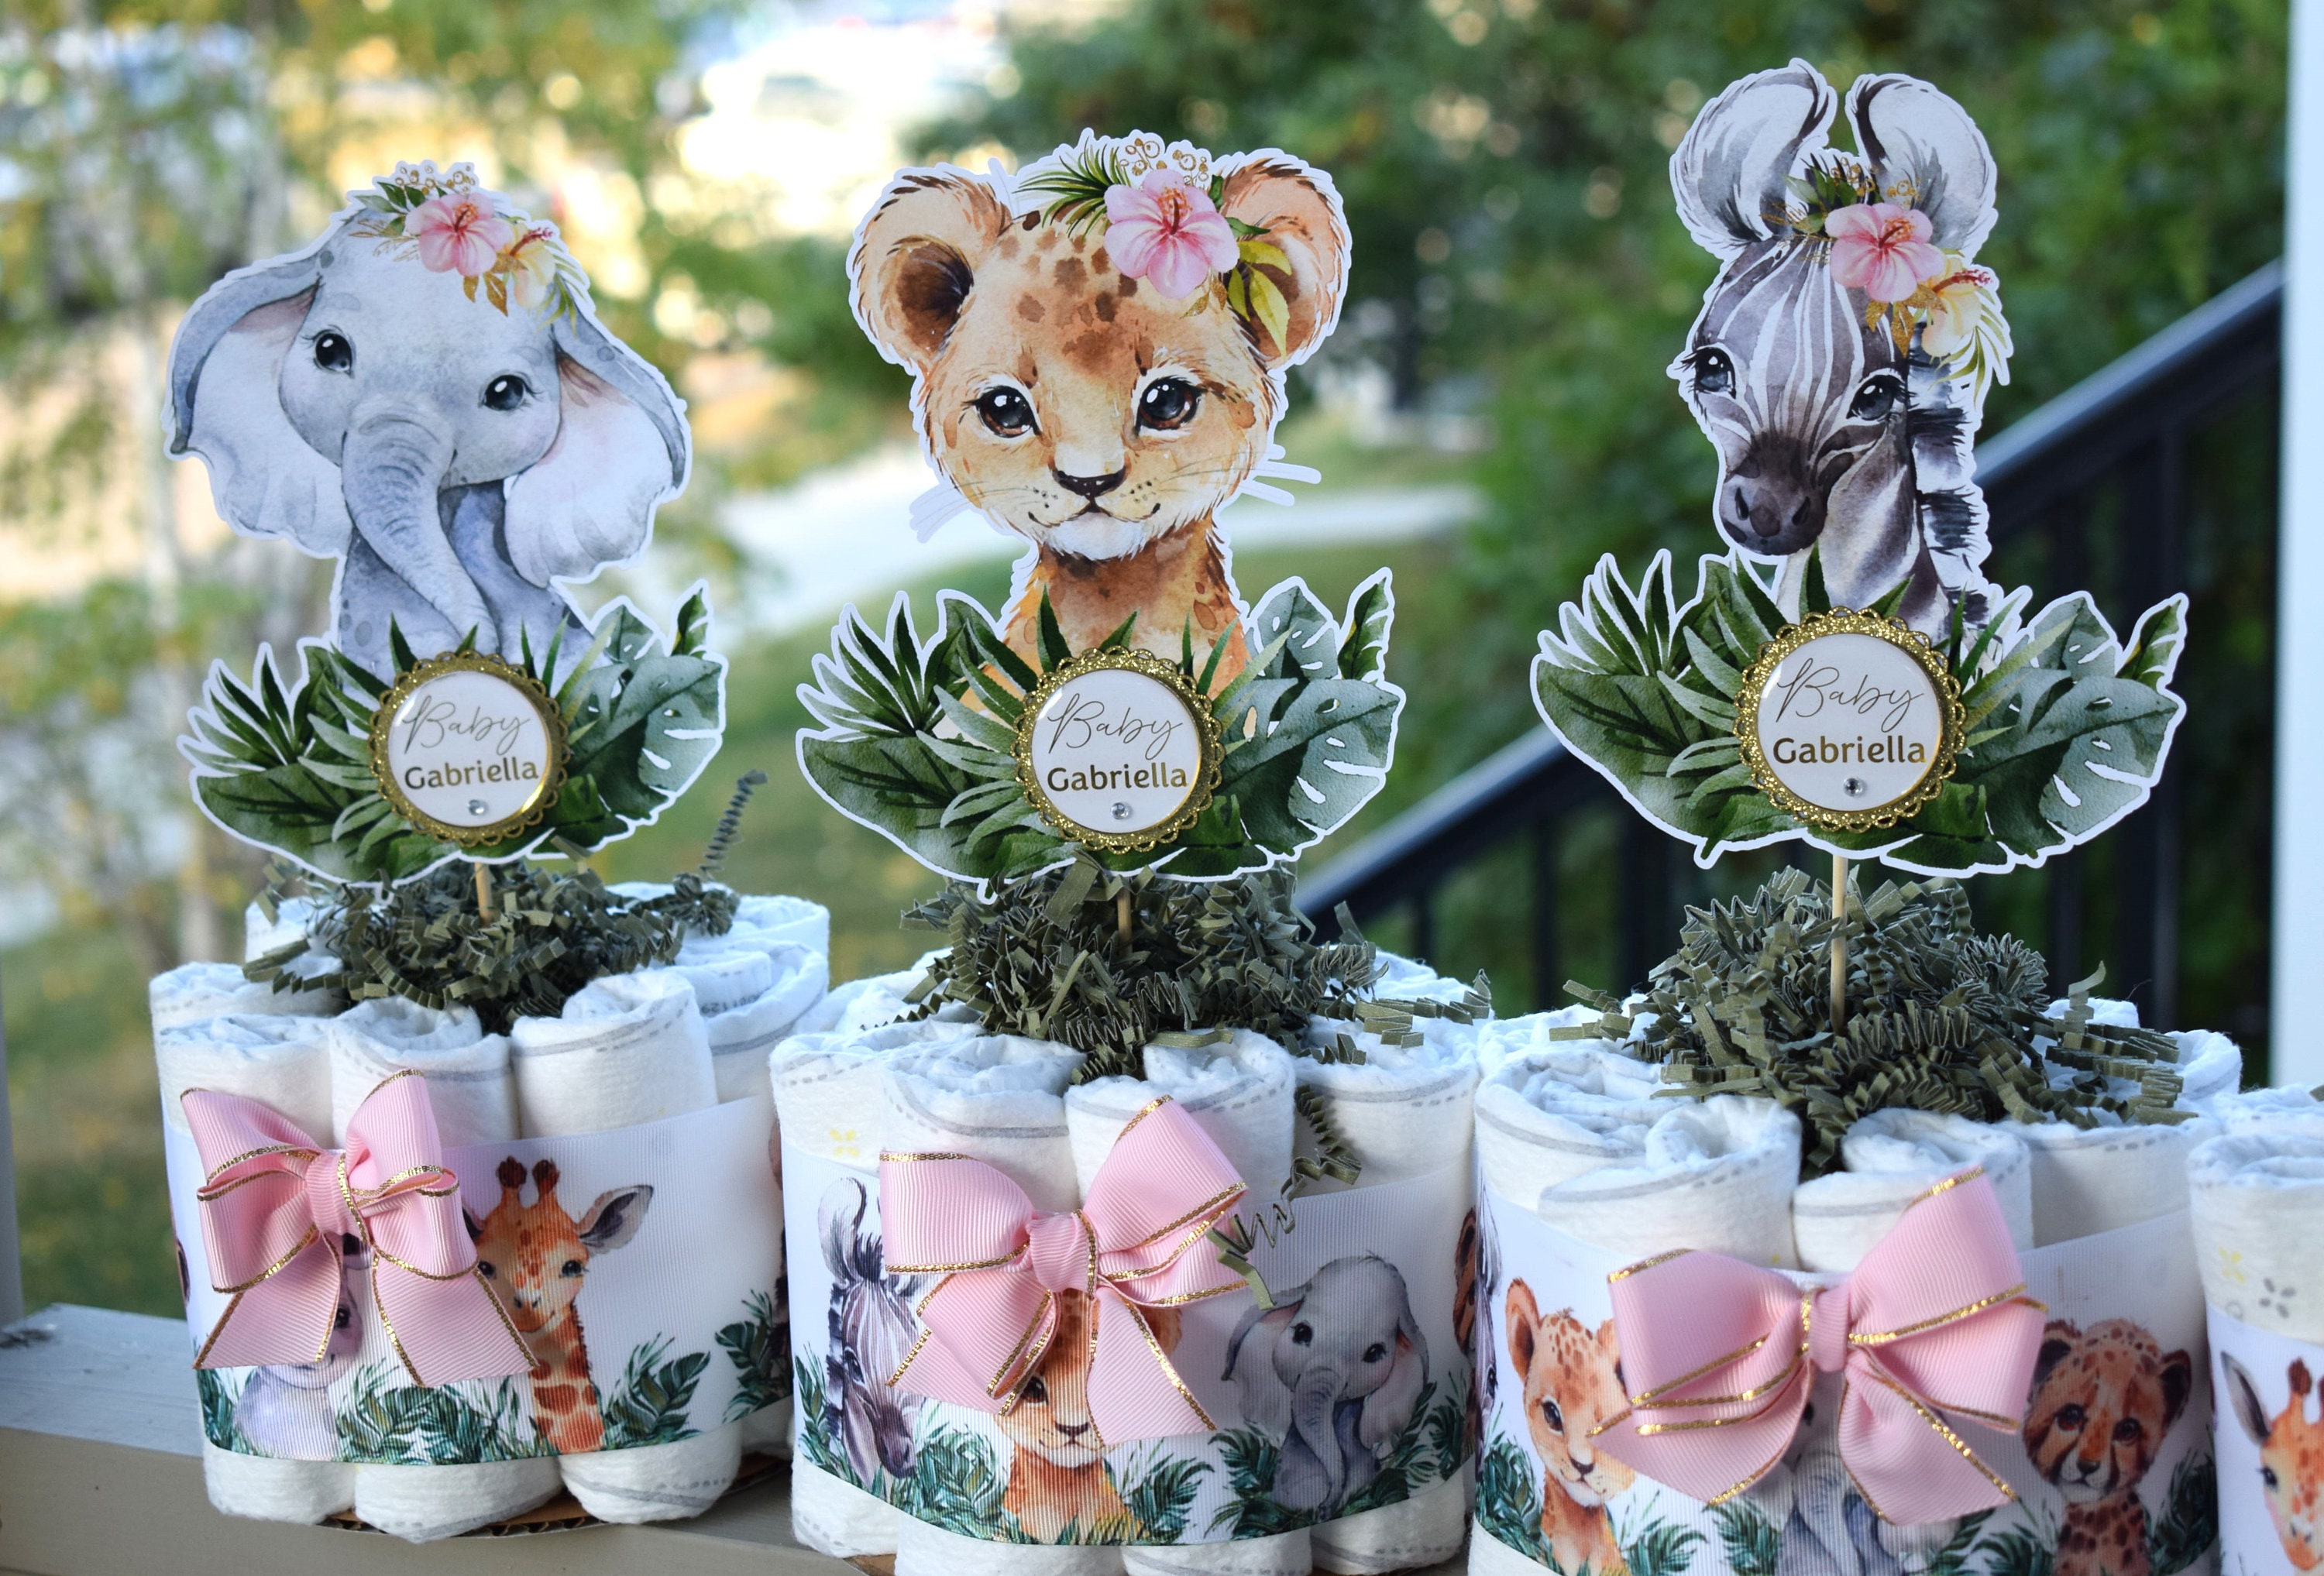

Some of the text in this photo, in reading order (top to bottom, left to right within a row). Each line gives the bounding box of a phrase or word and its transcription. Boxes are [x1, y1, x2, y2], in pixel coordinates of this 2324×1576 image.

[1776, 658, 1924, 733] Baby
[401, 695, 531, 756] Baby
[1047, 693, 1183, 761] Baby
[1773, 735, 1927, 764] Gabriella
[404, 757, 539, 790] Gabriella
[1047, 761, 1188, 791] Gabriella
